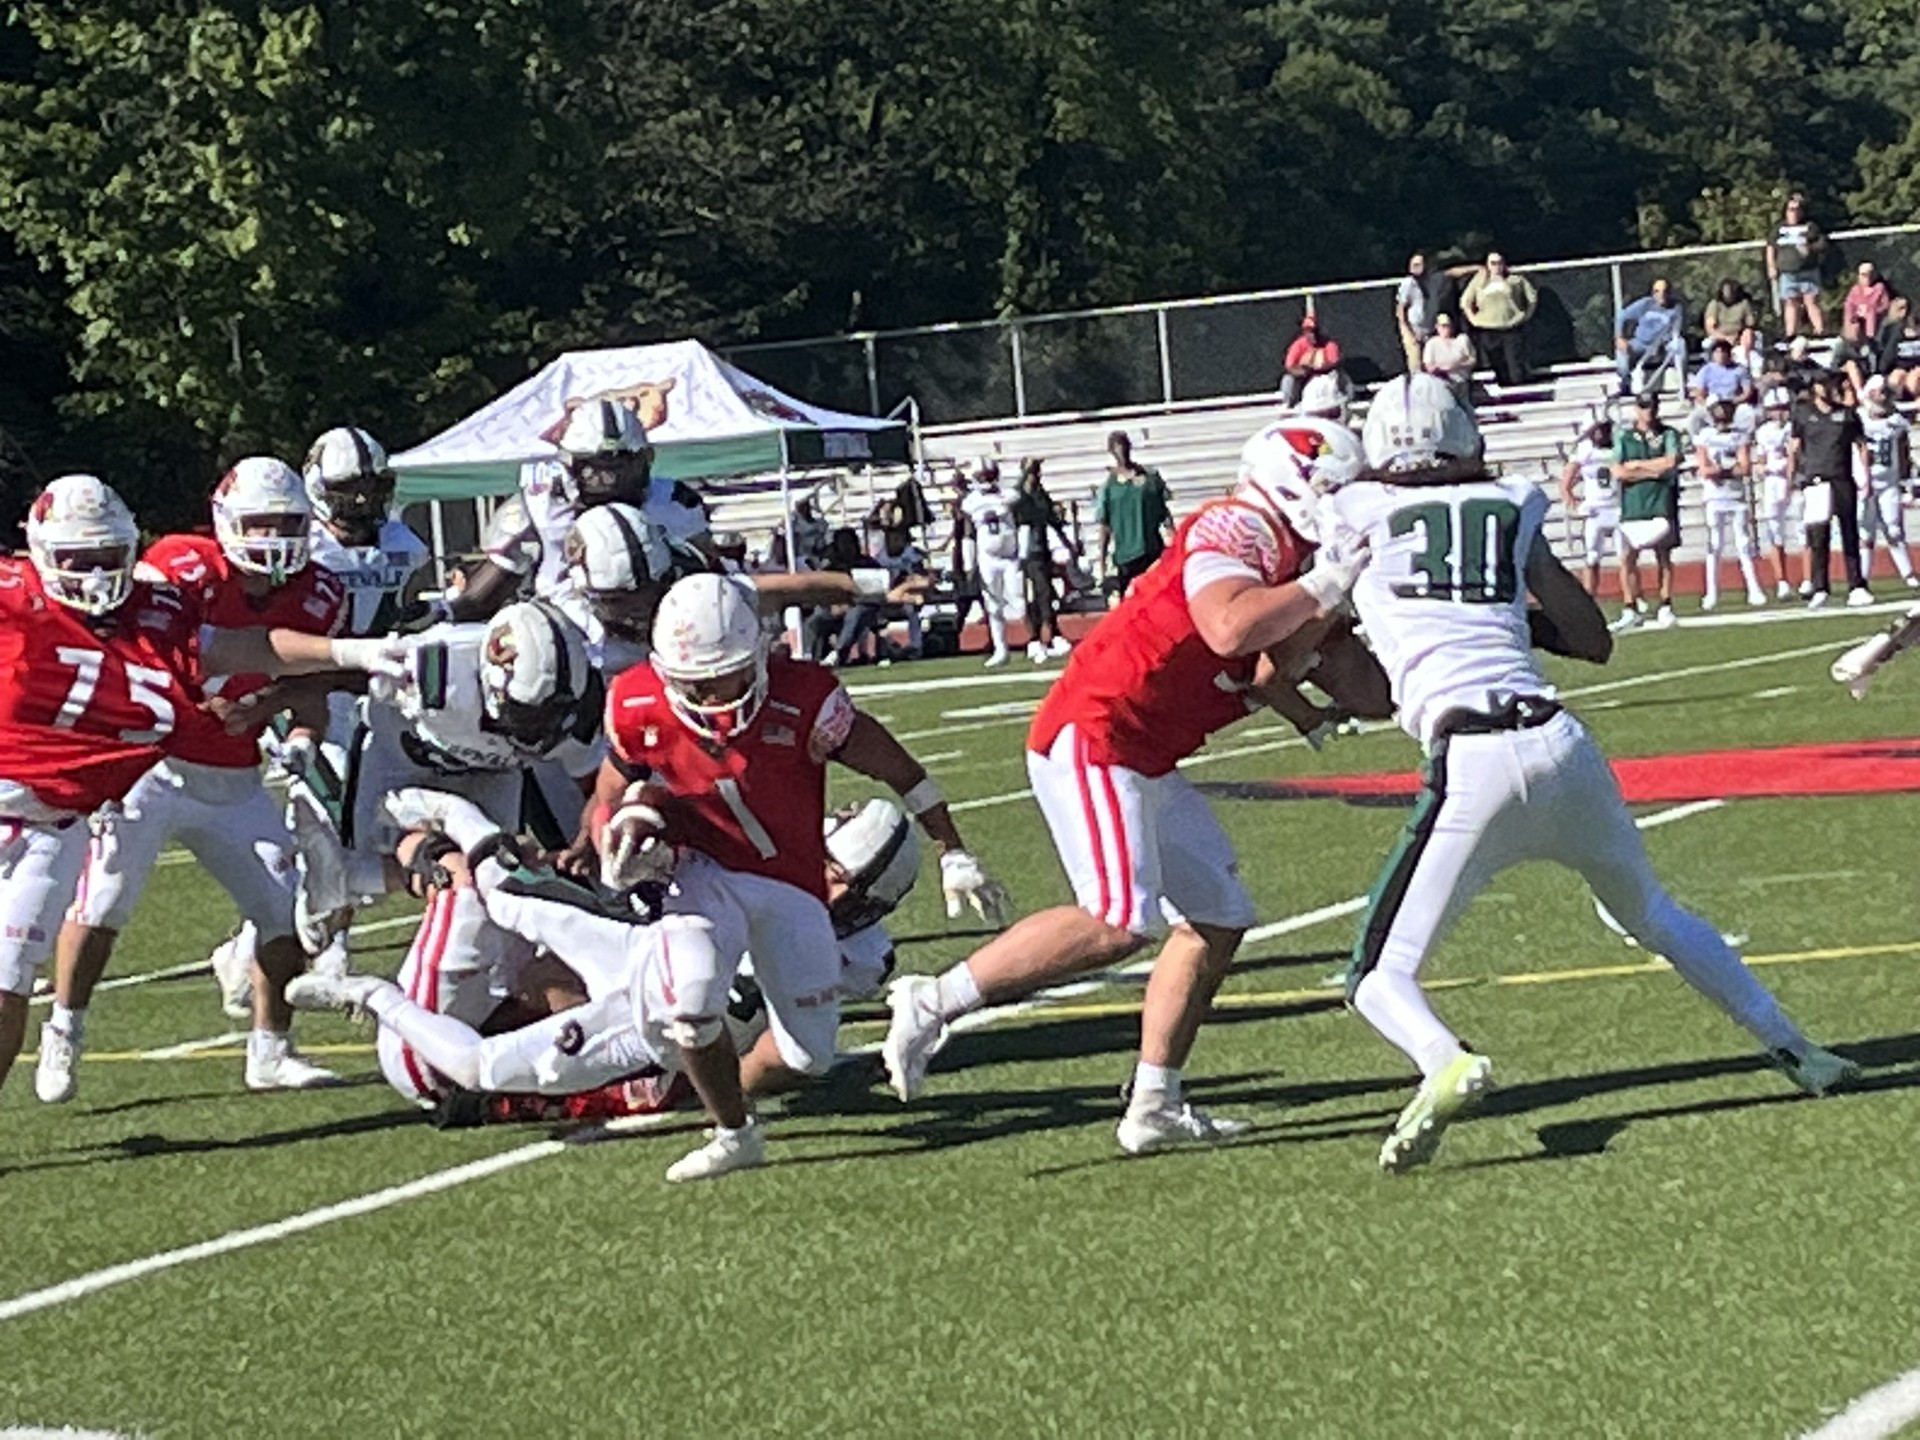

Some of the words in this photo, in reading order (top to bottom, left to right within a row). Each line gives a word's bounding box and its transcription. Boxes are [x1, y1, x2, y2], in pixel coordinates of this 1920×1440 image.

[1387, 497, 1521, 604] 30
[54, 645, 176, 745] 75
[715, 777, 778, 861] 1
